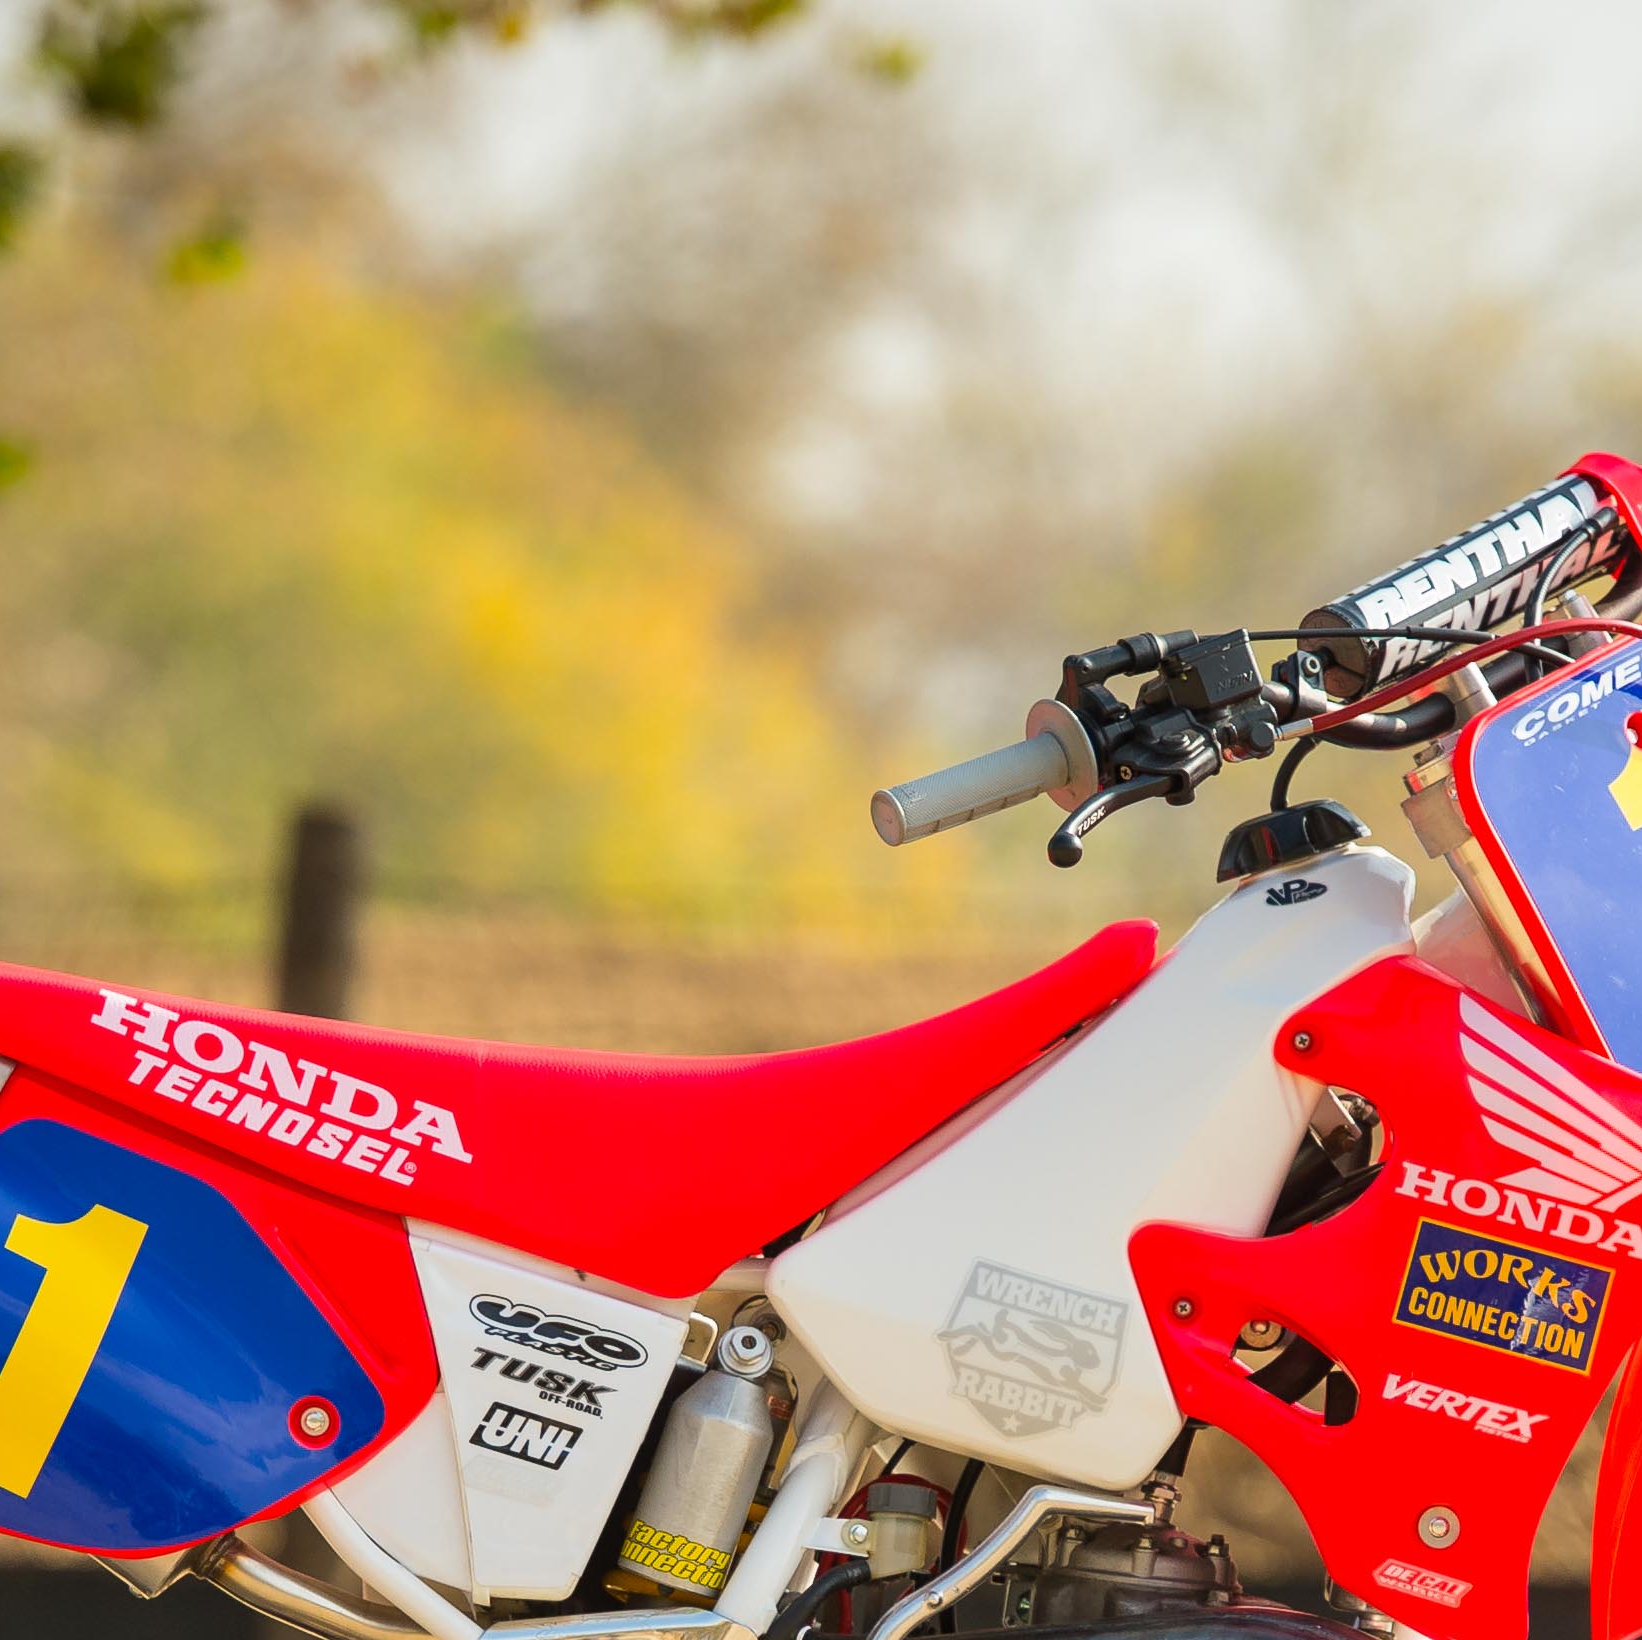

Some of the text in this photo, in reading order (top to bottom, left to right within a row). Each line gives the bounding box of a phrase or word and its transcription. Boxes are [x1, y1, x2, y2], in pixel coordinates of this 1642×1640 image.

[1077, 805, 1105, 836] TUSK
[90, 988, 474, 1164] HONDA
[975, 1266, 1121, 1335] WRENCH
[1419, 1249, 1596, 1324] WORKS
[476, 1300, 642, 1362] UFO
[1408, 1286, 1586, 1359] CONNECTION
[470, 1347, 618, 1408] TUSK
[954, 1365, 1084, 1428] RABBIT
[1382, 1373, 1550, 1439] VERTEX
[481, 1407, 576, 1466] UNI
[630, 1519, 731, 1570] Factory
